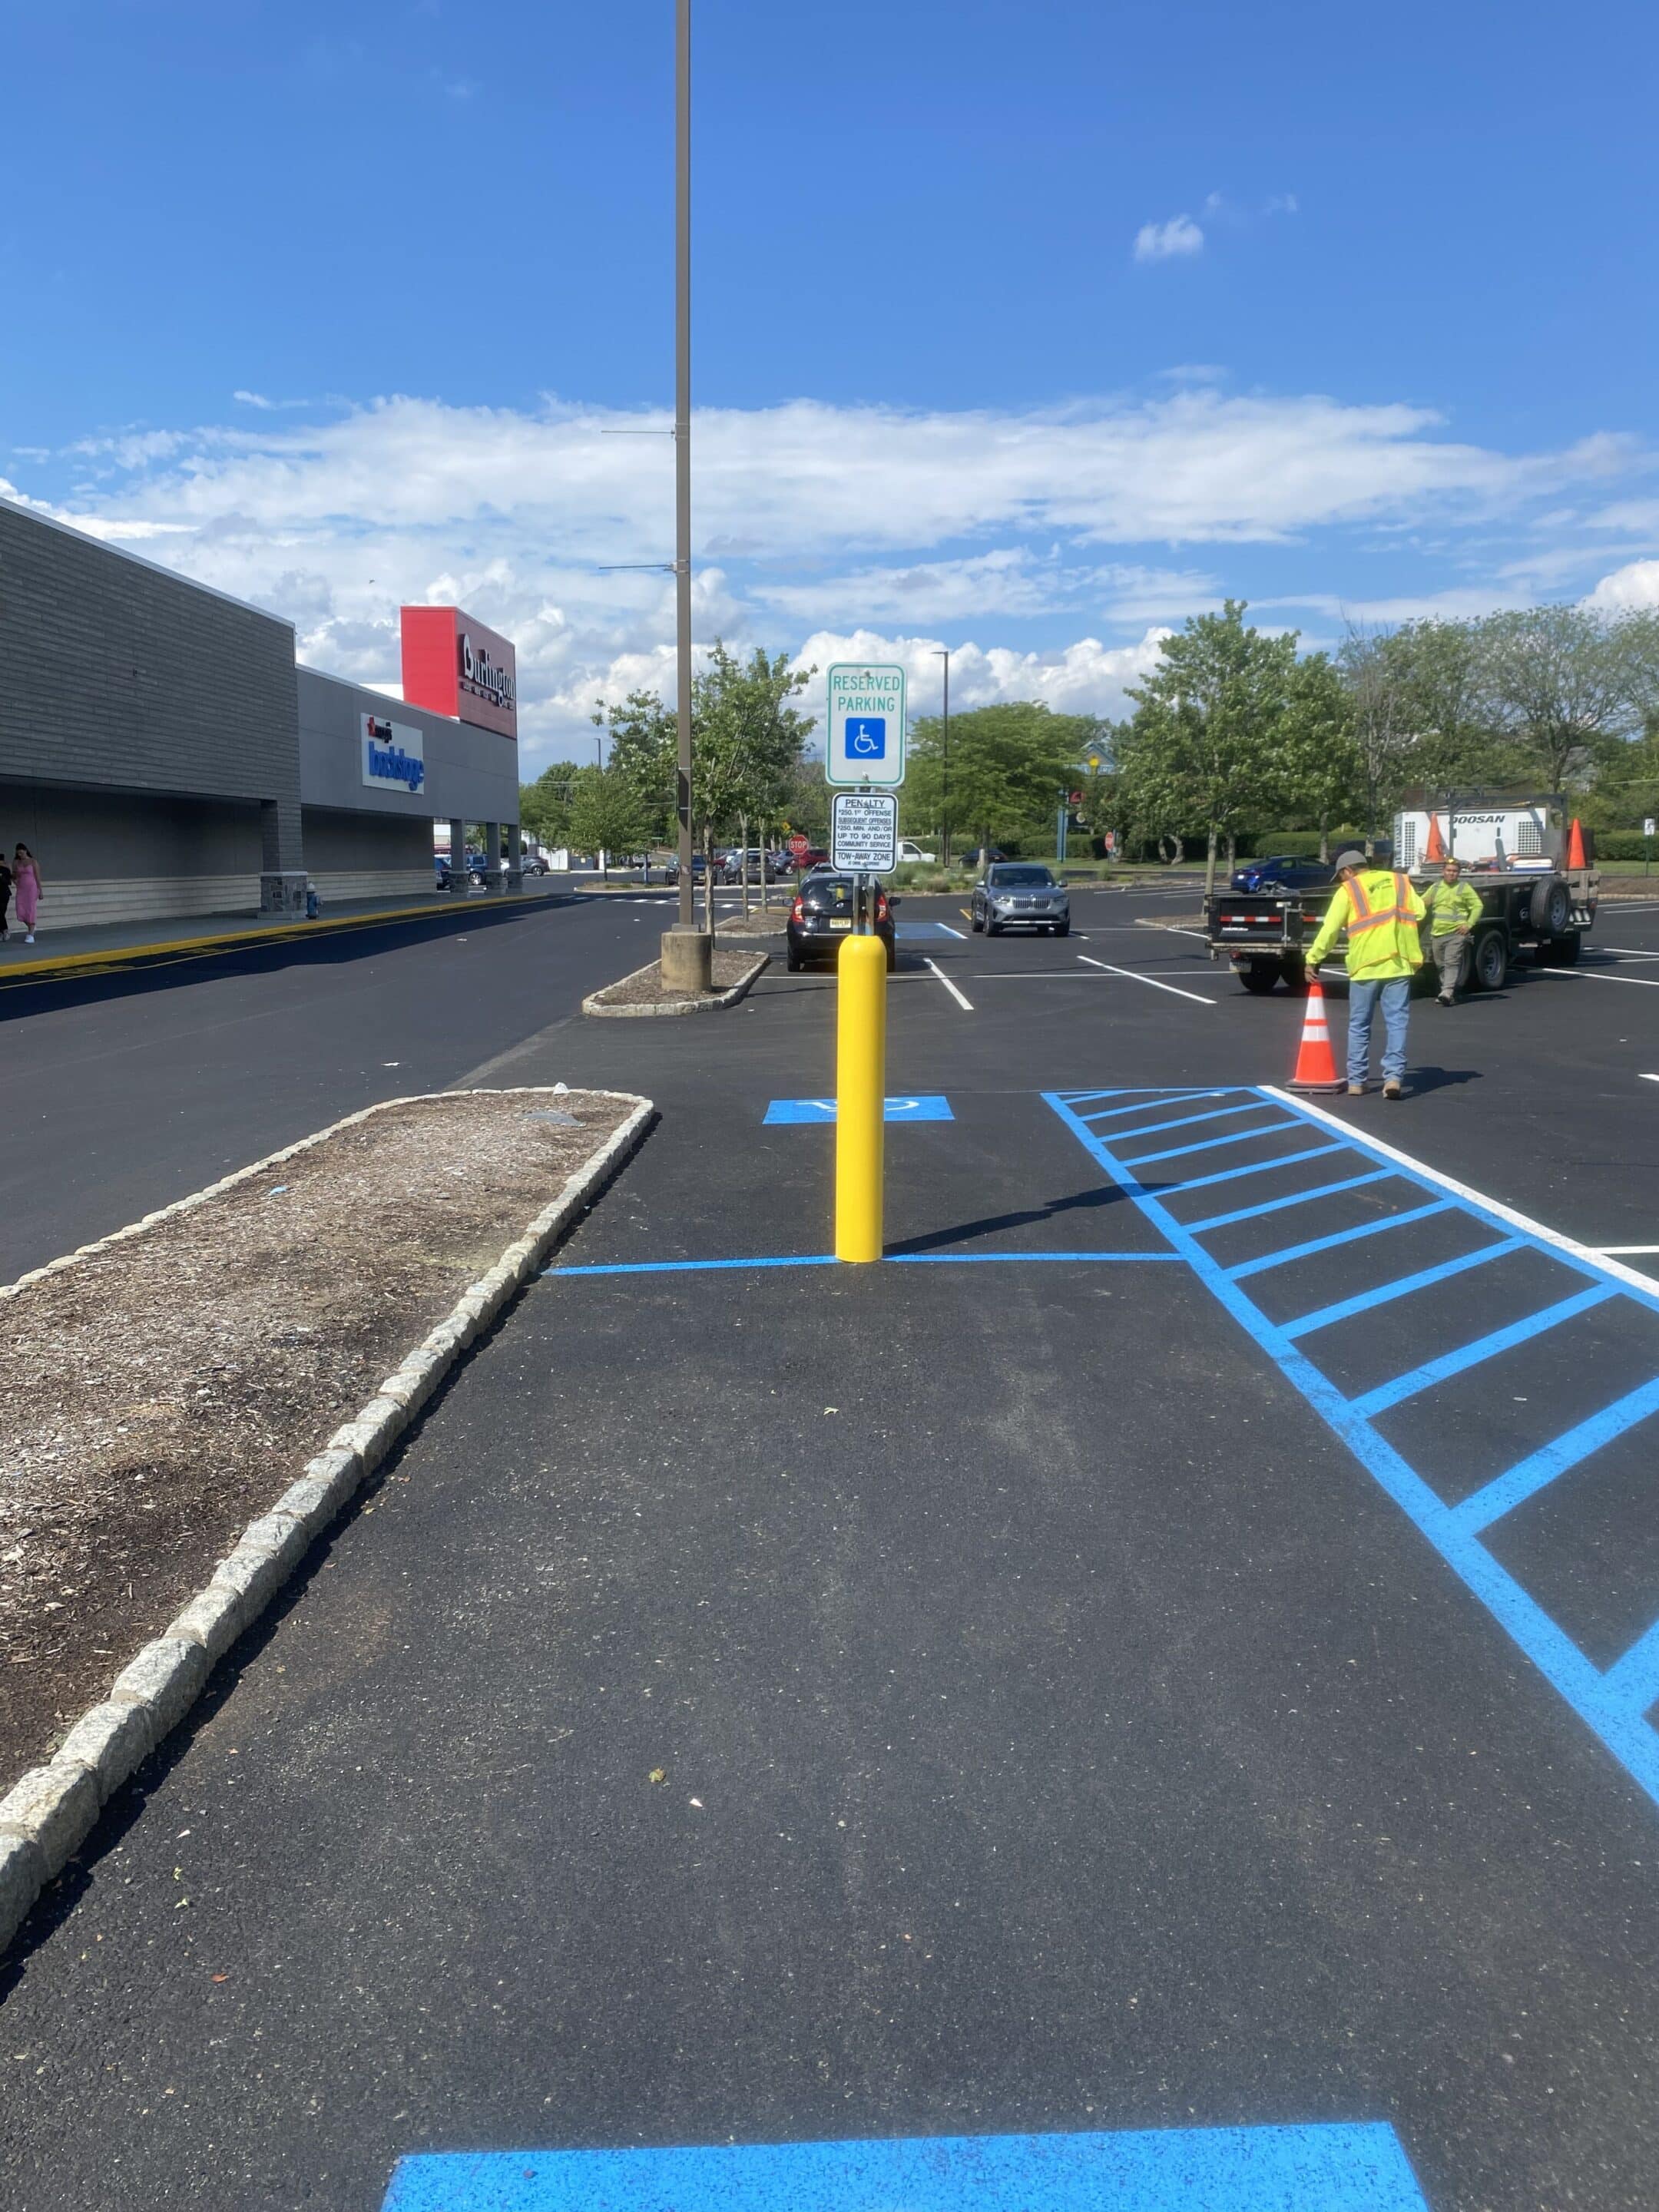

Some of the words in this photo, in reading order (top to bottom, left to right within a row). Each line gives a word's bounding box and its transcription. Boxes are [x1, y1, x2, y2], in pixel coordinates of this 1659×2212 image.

[463, 633, 515, 707] Burlington
[833, 676, 900, 691] RESERVED
[838, 697, 896, 712] PARKING
[790, 840, 806, 849] STOP
[837, 852, 871, 860] TOW-AWAY
[873, 853, 891, 861] ZONE
